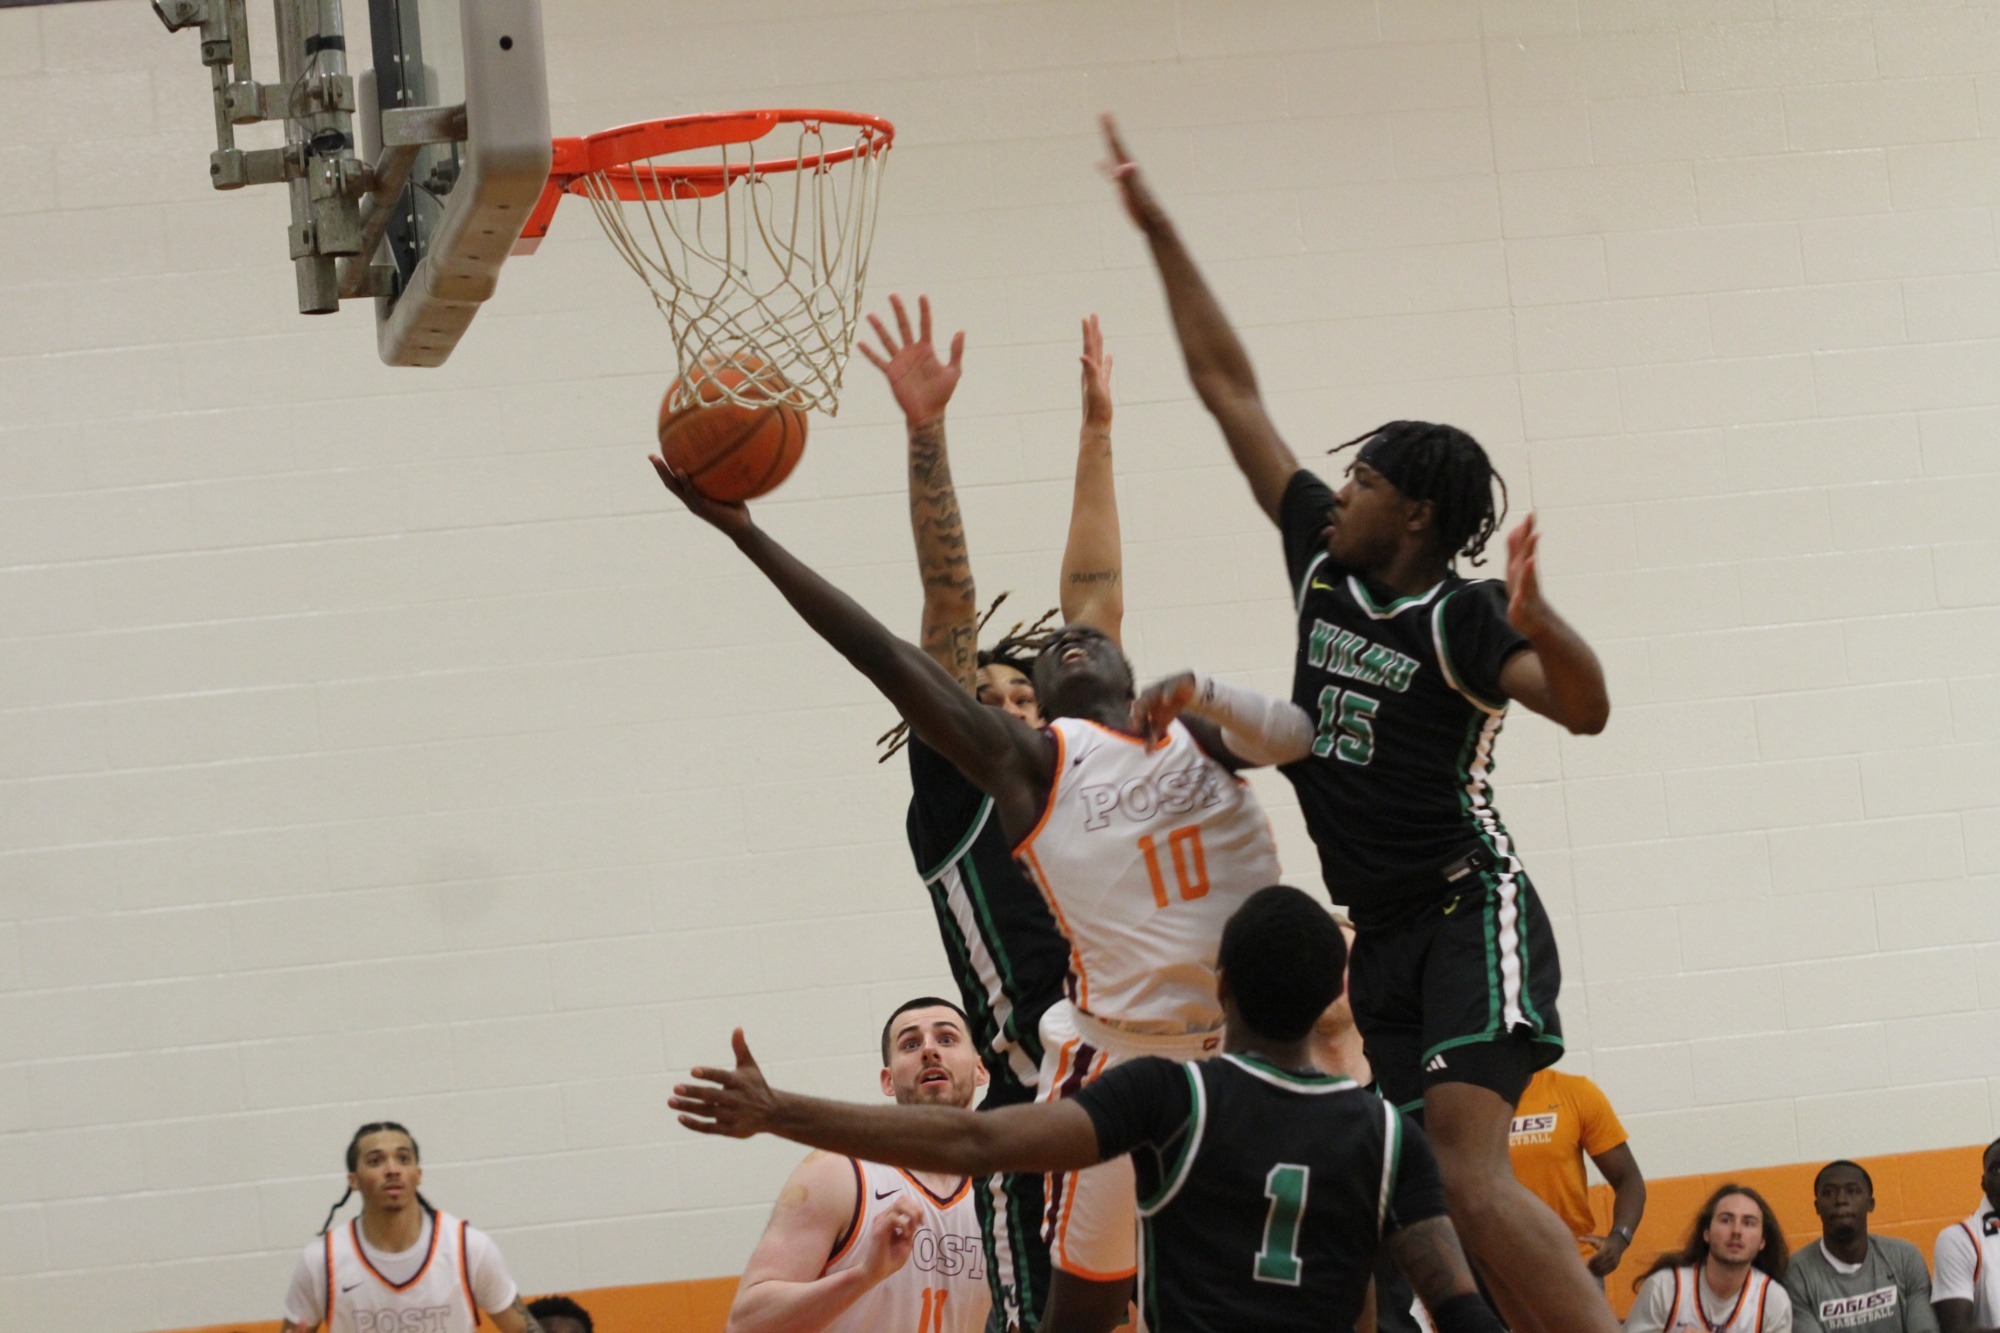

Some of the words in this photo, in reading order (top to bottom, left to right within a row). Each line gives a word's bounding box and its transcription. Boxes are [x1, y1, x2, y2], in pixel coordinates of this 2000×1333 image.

[1308, 618, 1421, 693] WILMU
[1312, 685, 1380, 766] 15
[1137, 823, 1211, 909] 10
[1511, 1116, 1553, 1133] LES
[1253, 1162, 1310, 1287] 1
[912, 1228, 983, 1280] OST
[352, 1305, 452, 1333] POST
[918, 1287, 949, 1333] 11
[1823, 1290, 1893, 1317] EAGLES
[1828, 1305, 1894, 1330] BASKETBALL
